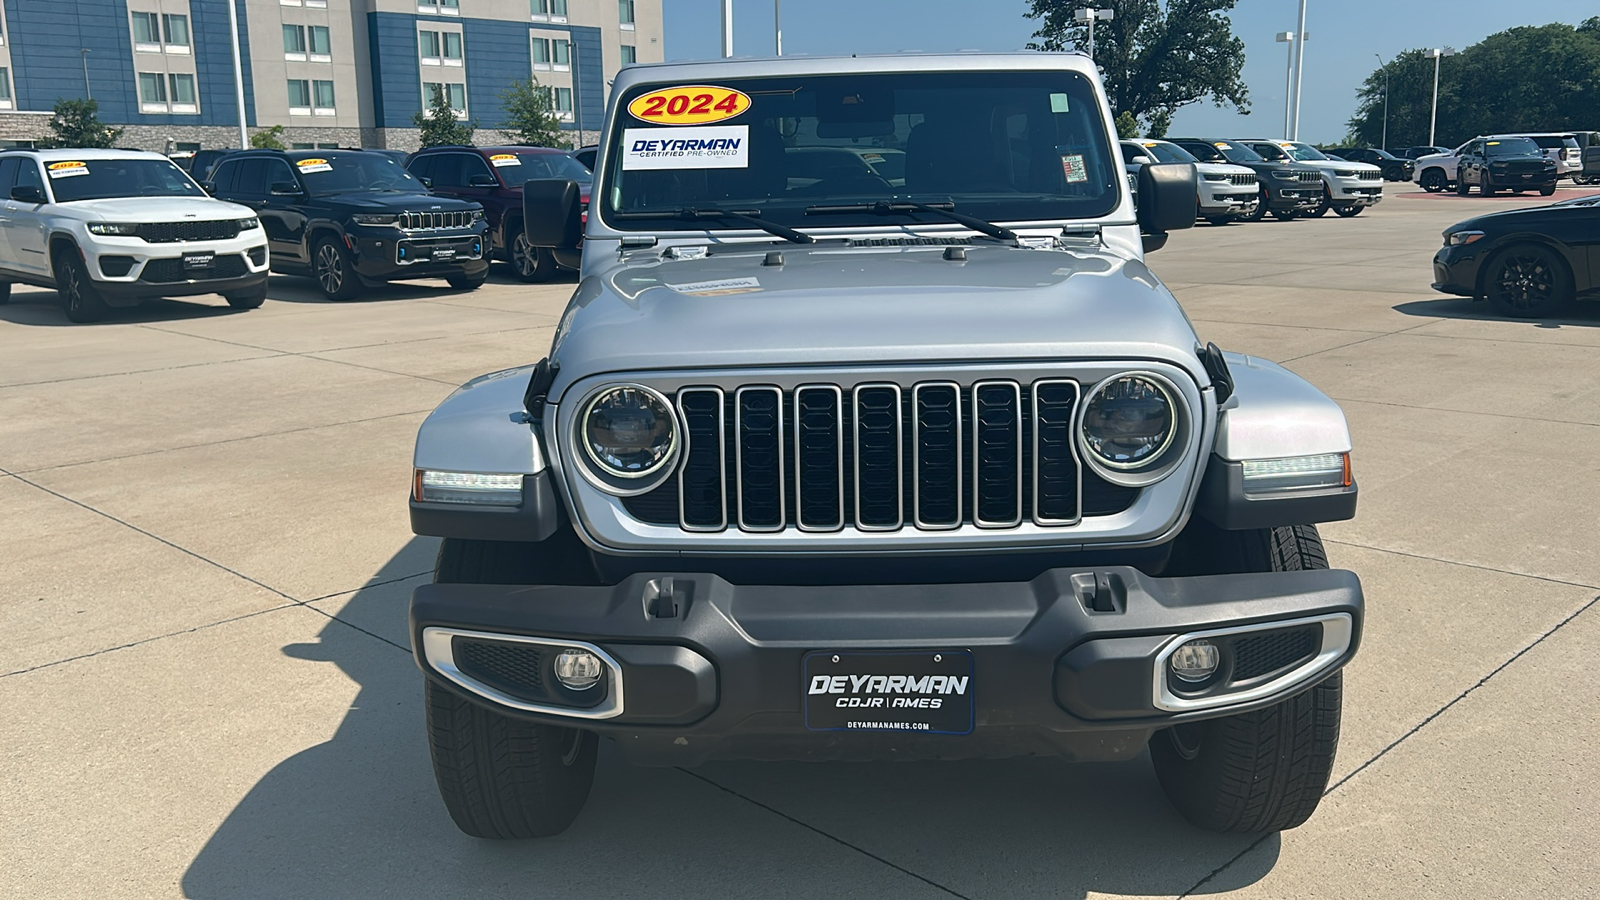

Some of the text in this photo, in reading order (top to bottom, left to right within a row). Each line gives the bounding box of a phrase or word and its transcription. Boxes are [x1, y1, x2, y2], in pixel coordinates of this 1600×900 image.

[641, 93, 738, 117] 2024
[631, 138, 742, 152] DEYARMAN
[686, 149, 738, 157] PRE-OWNED
[808, 674, 969, 695] DEYARMAN
[835, 697, 943, 709] CDJR AMES
[847, 721, 930, 731] DEYARMANAMES.COM
